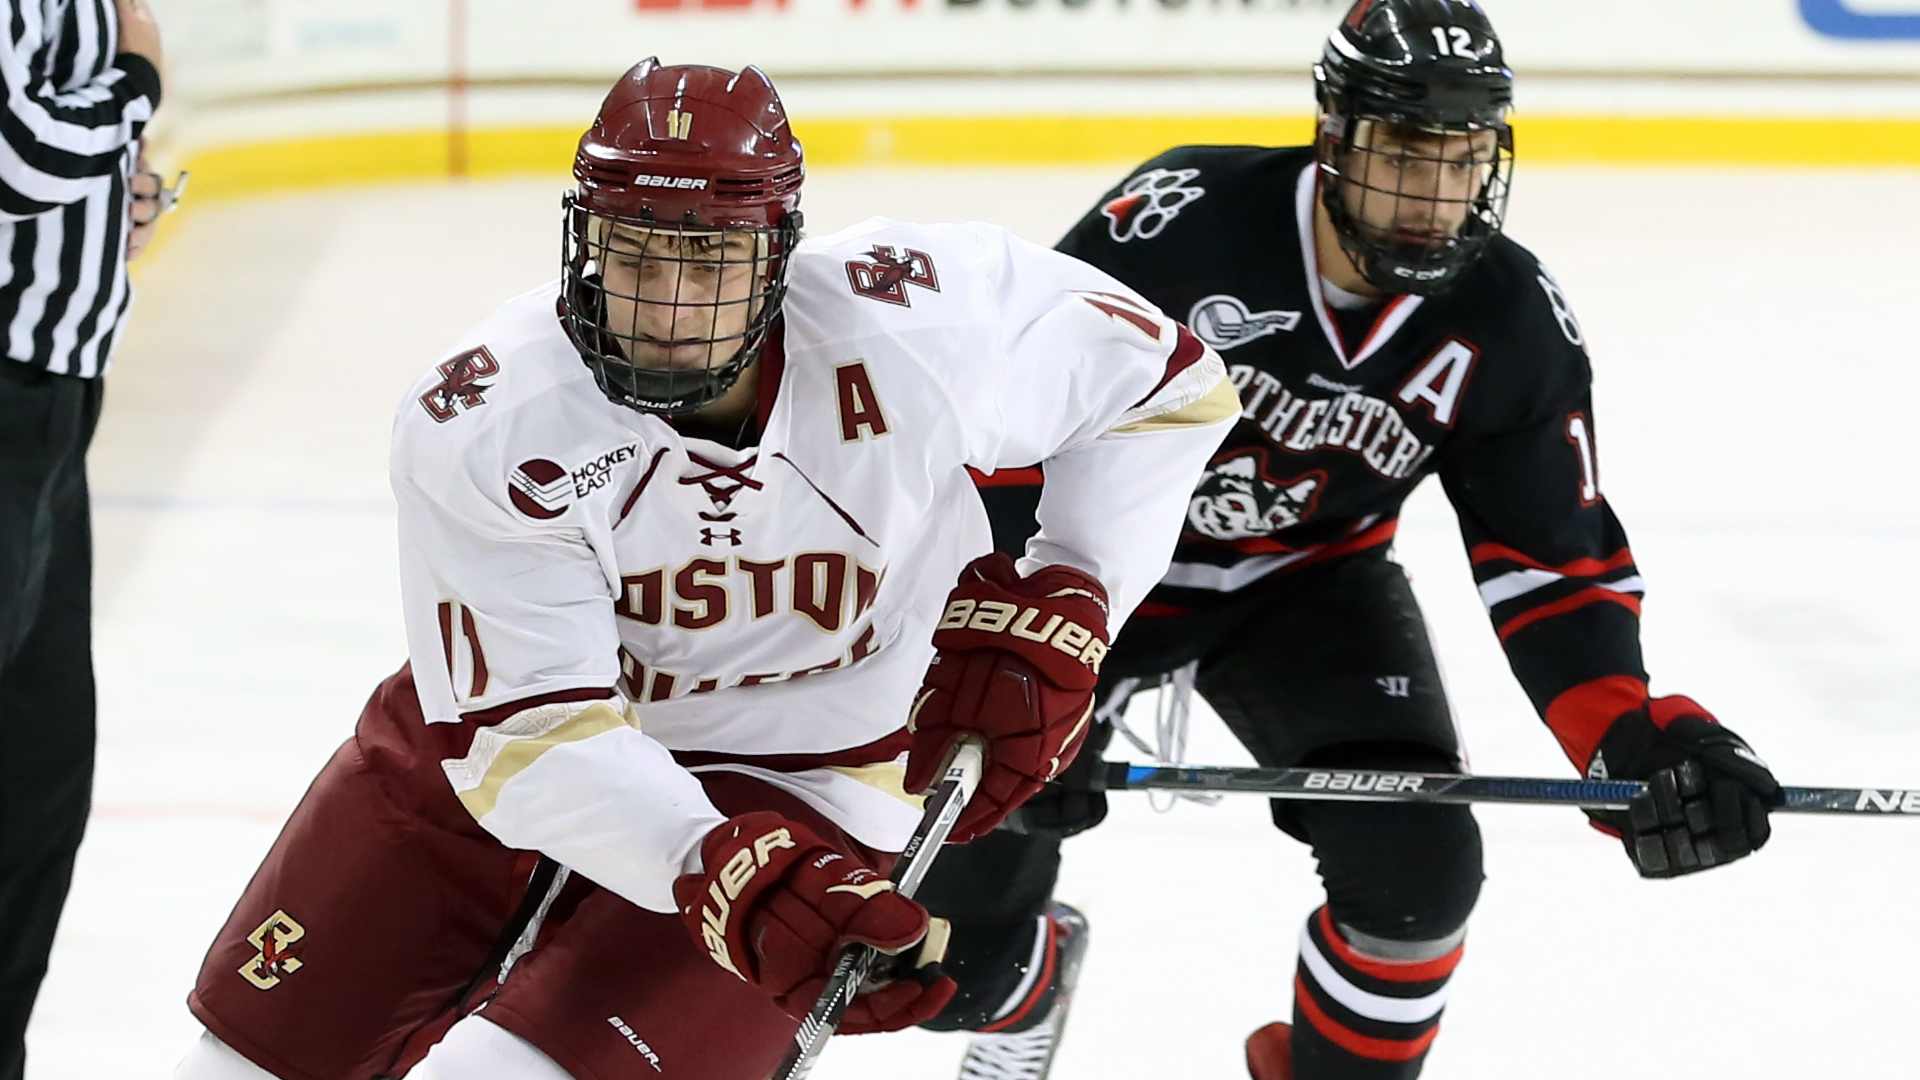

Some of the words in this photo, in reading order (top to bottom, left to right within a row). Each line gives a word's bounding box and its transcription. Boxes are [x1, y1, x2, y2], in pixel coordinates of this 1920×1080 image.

[1431, 26, 1480, 62] 12
[667, 109, 693, 140] 11
[634, 174, 708, 190] BAUER
[832, 357, 891, 444] A
[1396, 337, 1478, 428] A
[571, 444, 638, 486] HOCKEY
[575, 468, 613, 500] EAST
[615, 550, 890, 634] OSTO
[937, 598, 1110, 676] BAUER
[1303, 771, 1425, 793] BAUER
[606, 1015, 661, 1067] BAUER
